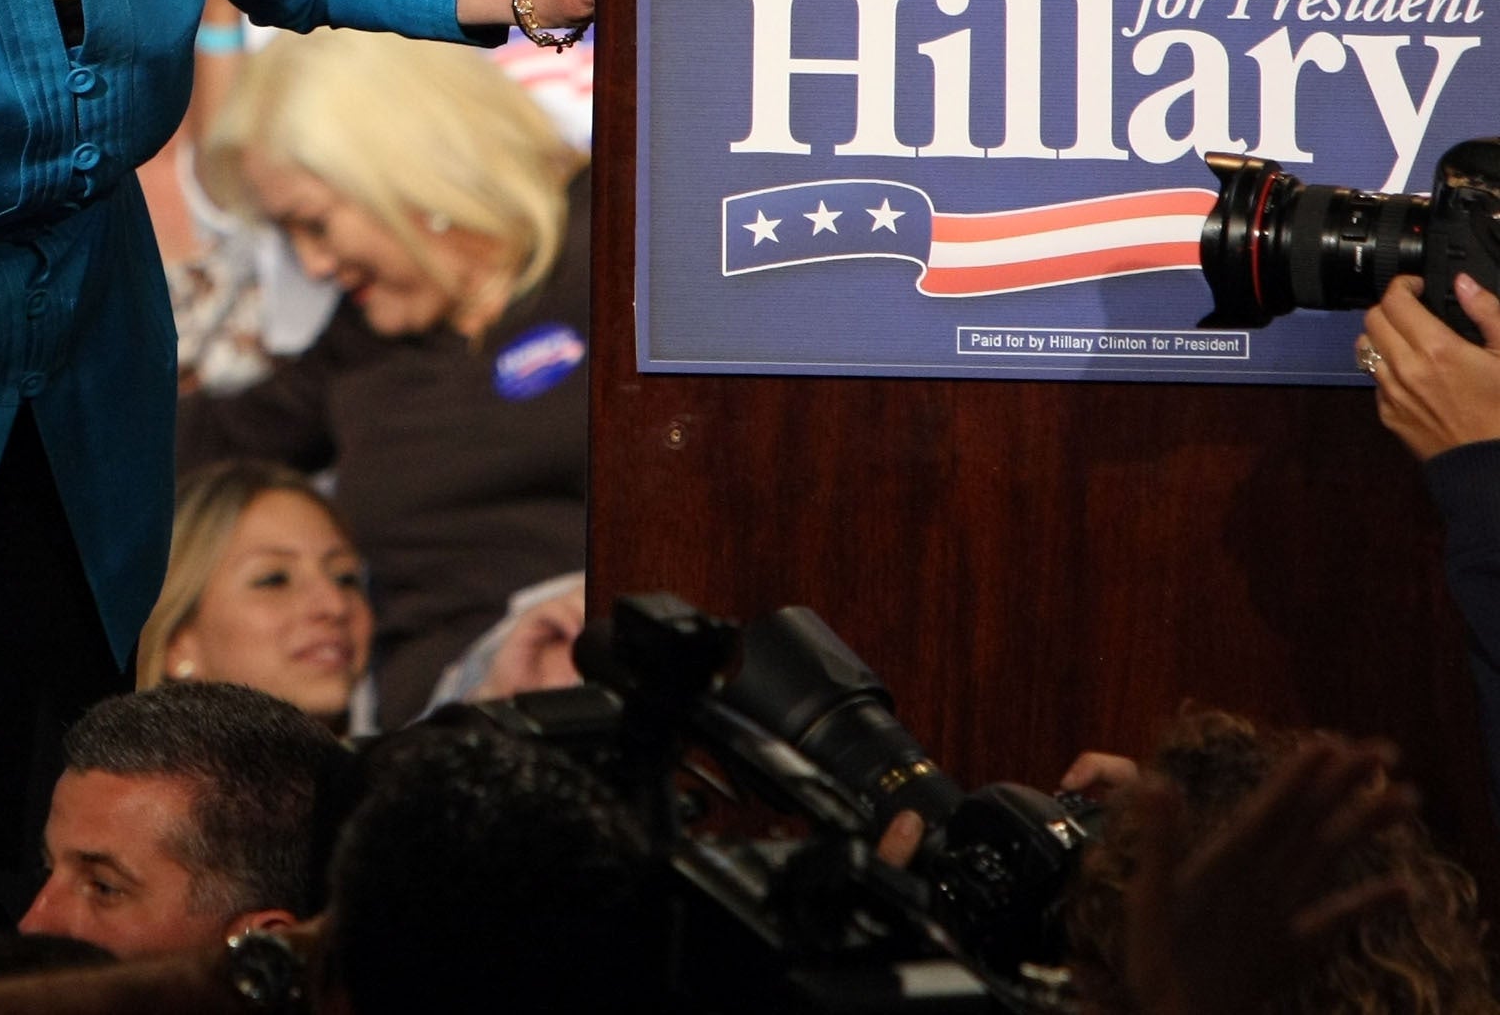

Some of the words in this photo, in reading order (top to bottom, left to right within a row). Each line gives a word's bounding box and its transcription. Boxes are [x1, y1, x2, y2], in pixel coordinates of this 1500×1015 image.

[971, 333, 1001, 349] Paid
[1005, 333, 1025, 349] for
[1028, 334, 1045, 353] by
[1049, 334, 1094, 353] Hillary
[1098, 335, 1147, 351] Clinton
[1151, 337, 1171, 351] for
[1174, 337, 1240, 353] President
